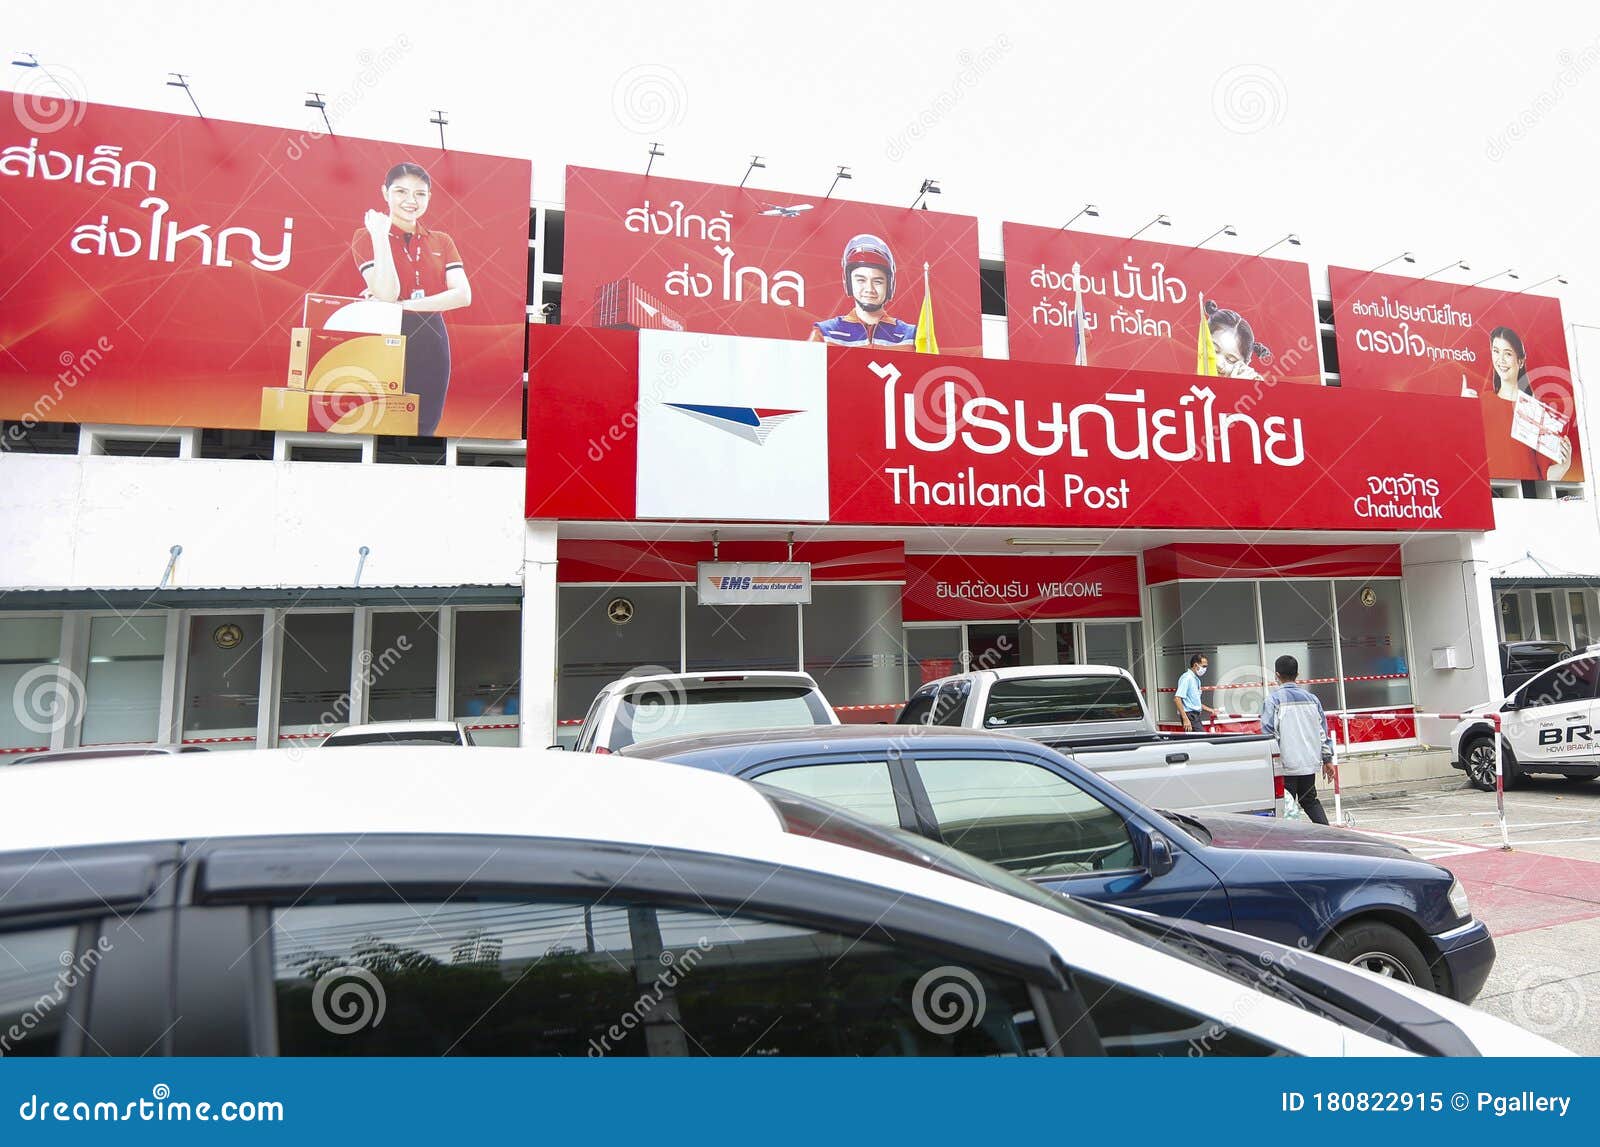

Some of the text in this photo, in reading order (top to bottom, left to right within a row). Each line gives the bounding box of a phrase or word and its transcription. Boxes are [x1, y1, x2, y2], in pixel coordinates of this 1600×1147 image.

[0, 138, 157, 191] ส่งเล็ก
[624, 200, 733, 242] ส่งใกล้
[1030, 256, 1187, 304] ส่งดวน มั่นใจ
[1110, 306, 1172, 338] ทั่วโลก
[868, 361, 1304, 466] ไปรษณีย์ไทย
[886, 465, 1129, 509] Thailand Post
[1367, 473, 1440, 501] จตุจักร
[1354, 495, 1443, 519] Chatuchak
[720, 576, 752, 590] EMS
[936, 580, 1103, 598] ยินดีต้อนรับ WELCOME
[1546, 745, 1565, 753] HOW
[1566, 743, 1593, 752] BRAVE
